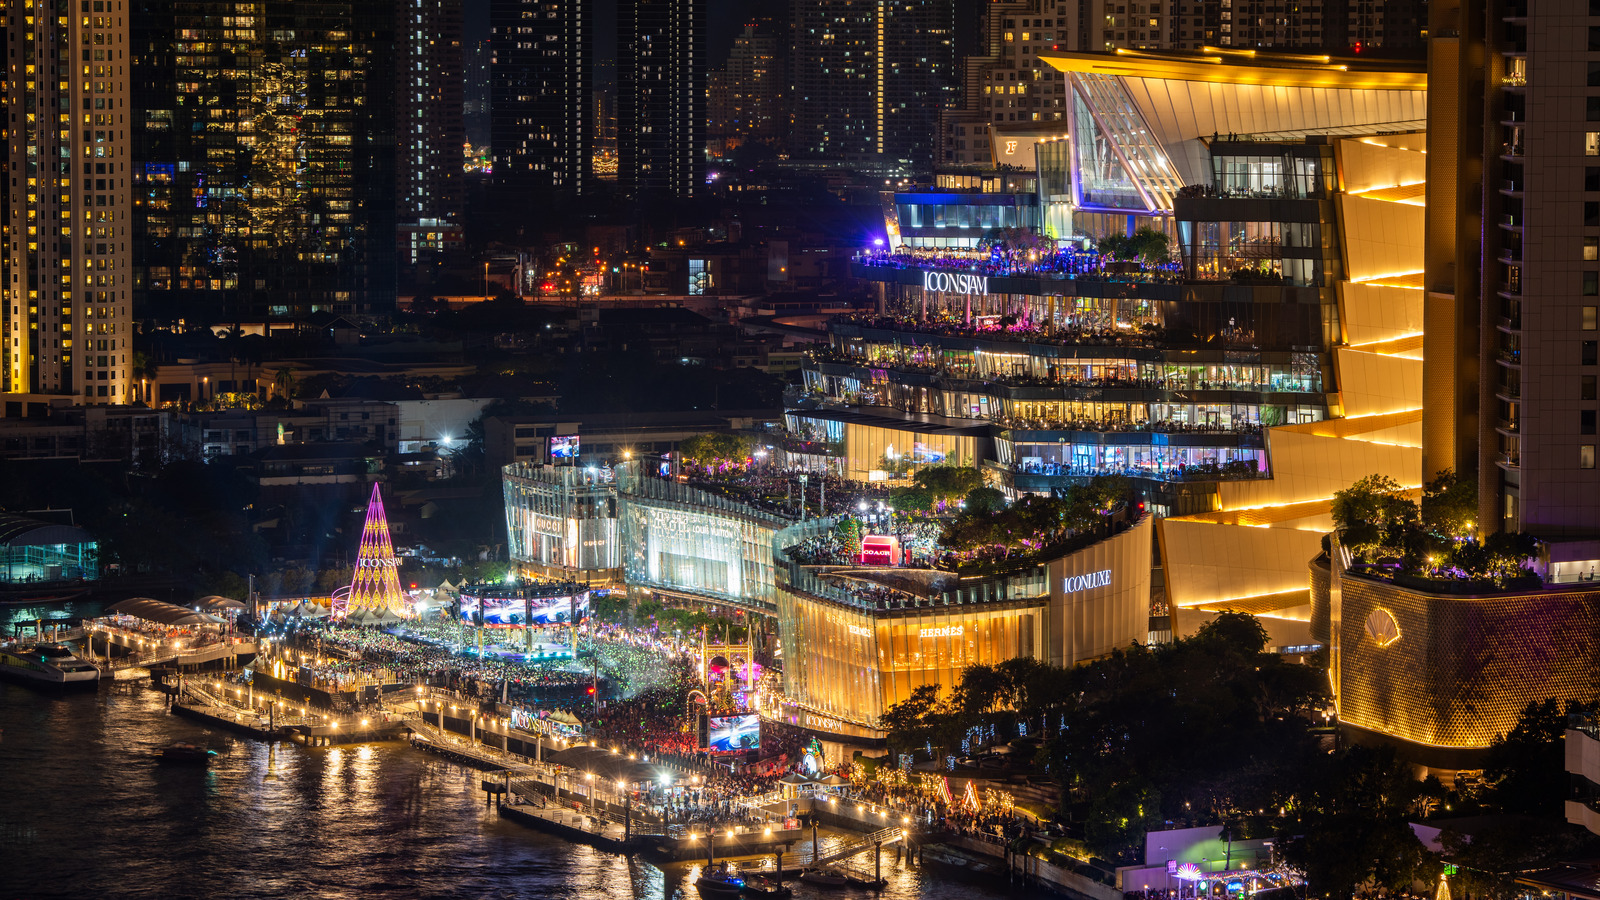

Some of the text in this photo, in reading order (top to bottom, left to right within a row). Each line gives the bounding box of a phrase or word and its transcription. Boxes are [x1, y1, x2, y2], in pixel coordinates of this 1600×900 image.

[924, 271, 988, 296] ICONSIAM
[536, 518, 560, 532] GUCCI
[1064, 569, 1112, 594] ICONLUXE
[806, 715, 843, 731] ICONSIAM
